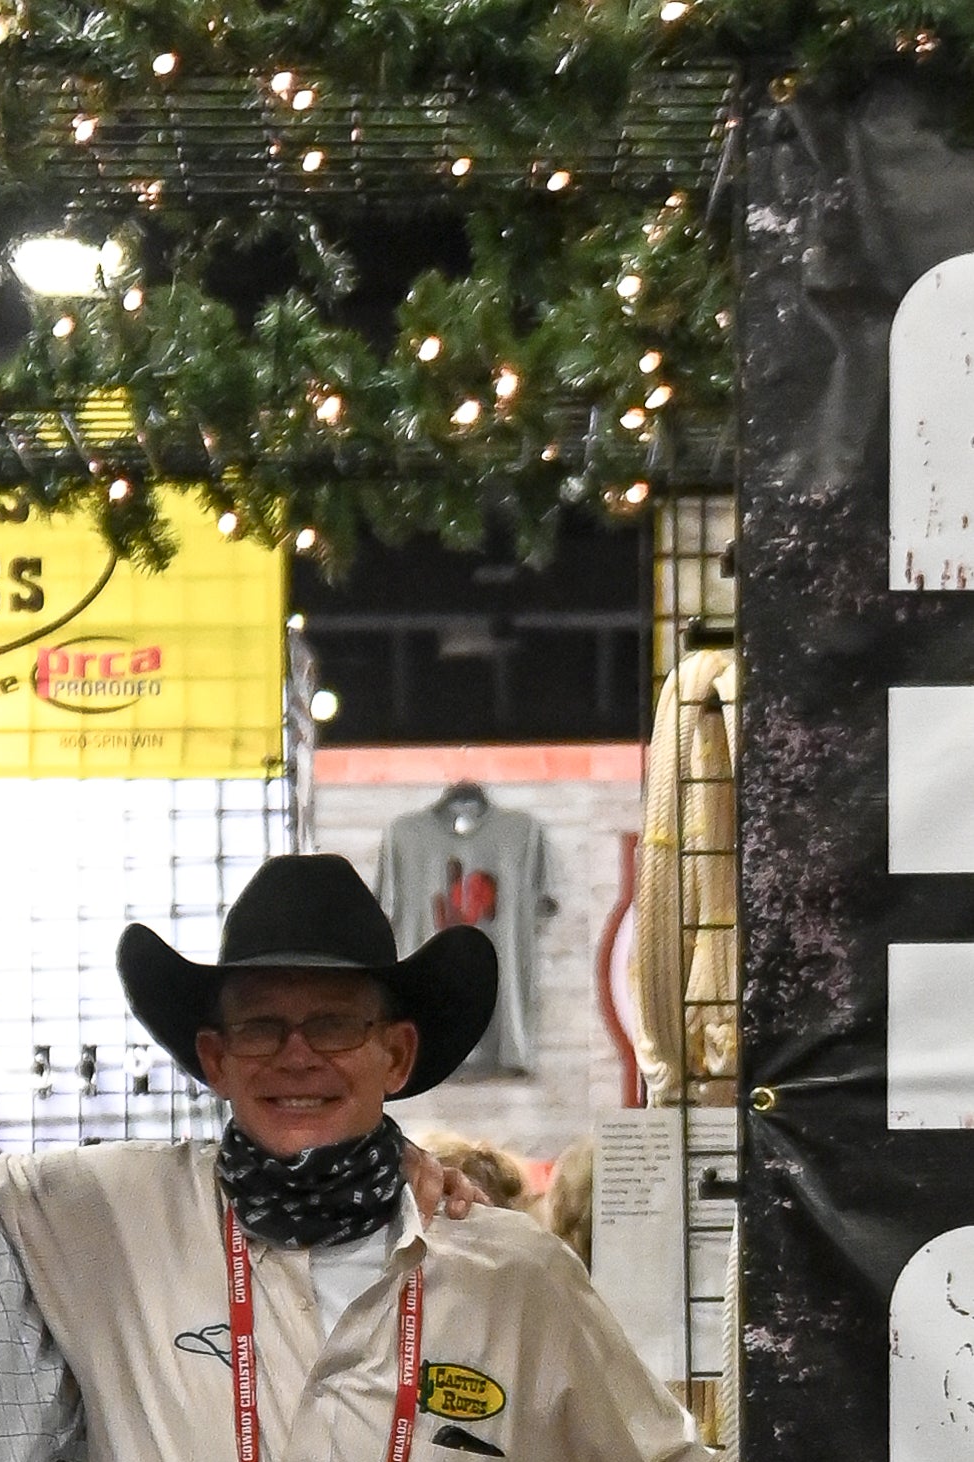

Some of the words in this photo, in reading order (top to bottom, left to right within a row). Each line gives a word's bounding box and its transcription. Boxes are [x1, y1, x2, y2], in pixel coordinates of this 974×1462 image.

[36, 645, 163, 698] prca
[53, 679, 162, 697] PRORODEO
[232, 1255, 246, 1304] COWBOY
[406, 1271, 417, 1313] OWBOY
[237, 1335, 251, 1408] CHRISTMAS
[403, 1314, 416, 1386] CHRISTMAS
[435, 1368, 487, 1394] CACTUS
[241, 1411, 253, 1462] COWBOY
